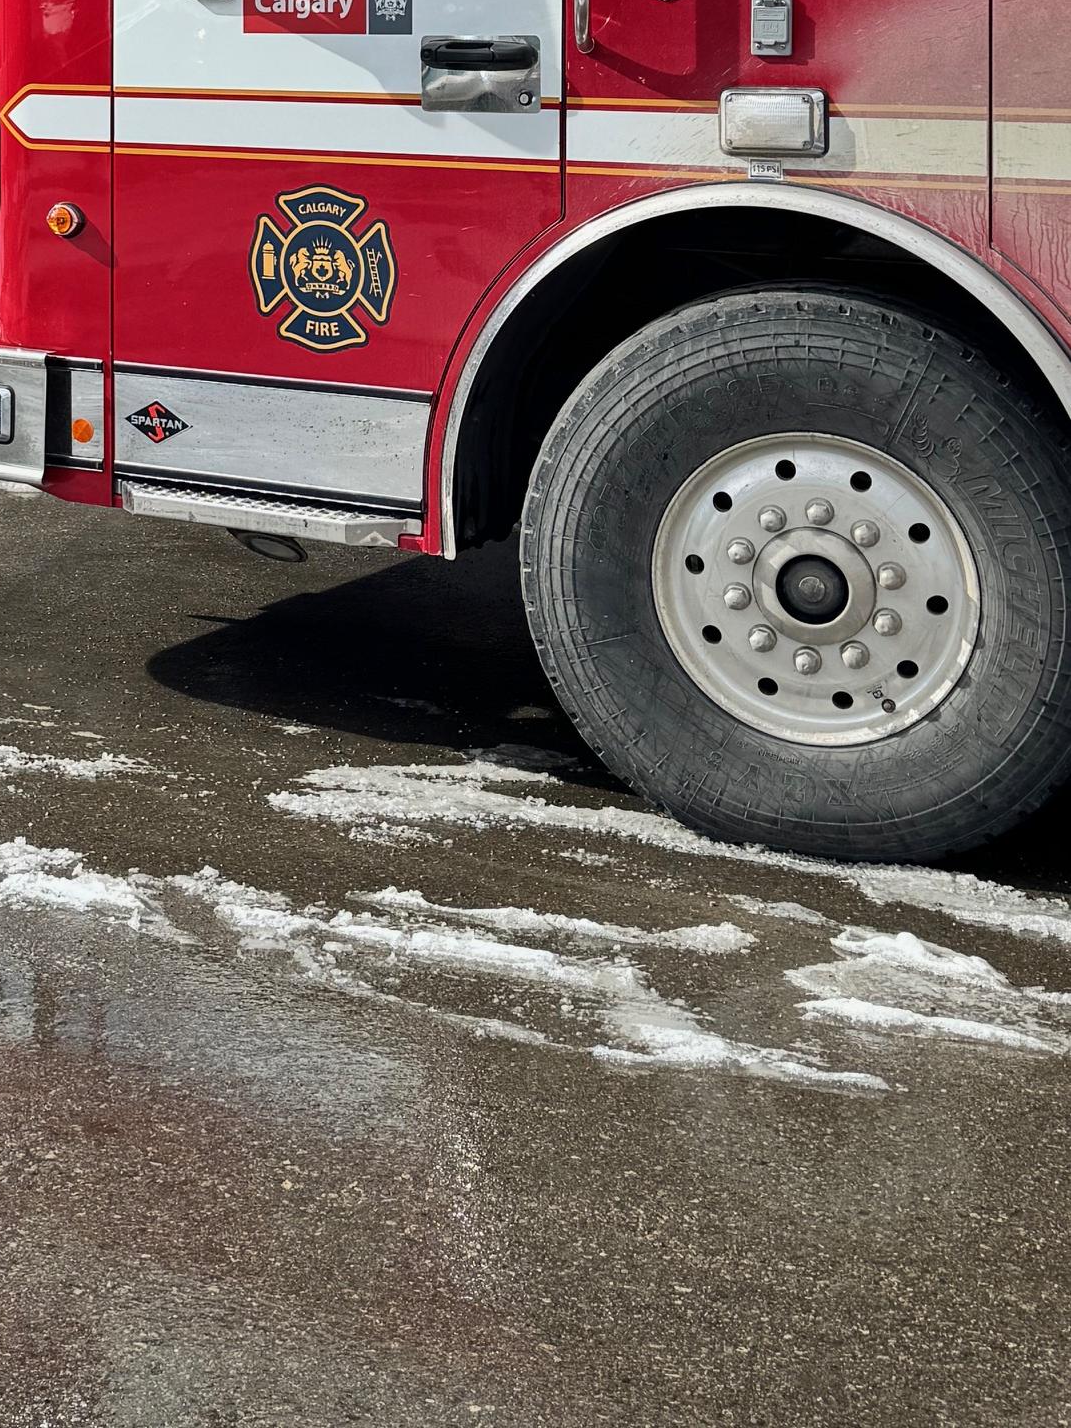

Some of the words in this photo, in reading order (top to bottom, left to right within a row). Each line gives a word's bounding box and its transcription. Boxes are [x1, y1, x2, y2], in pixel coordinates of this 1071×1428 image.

[298, 202, 347, 218] CALGARY
[305, 319, 341, 337] FIRE
[130, 414, 183, 431] SPARTAN
[963, 474, 1042, 739] MICHELIN
